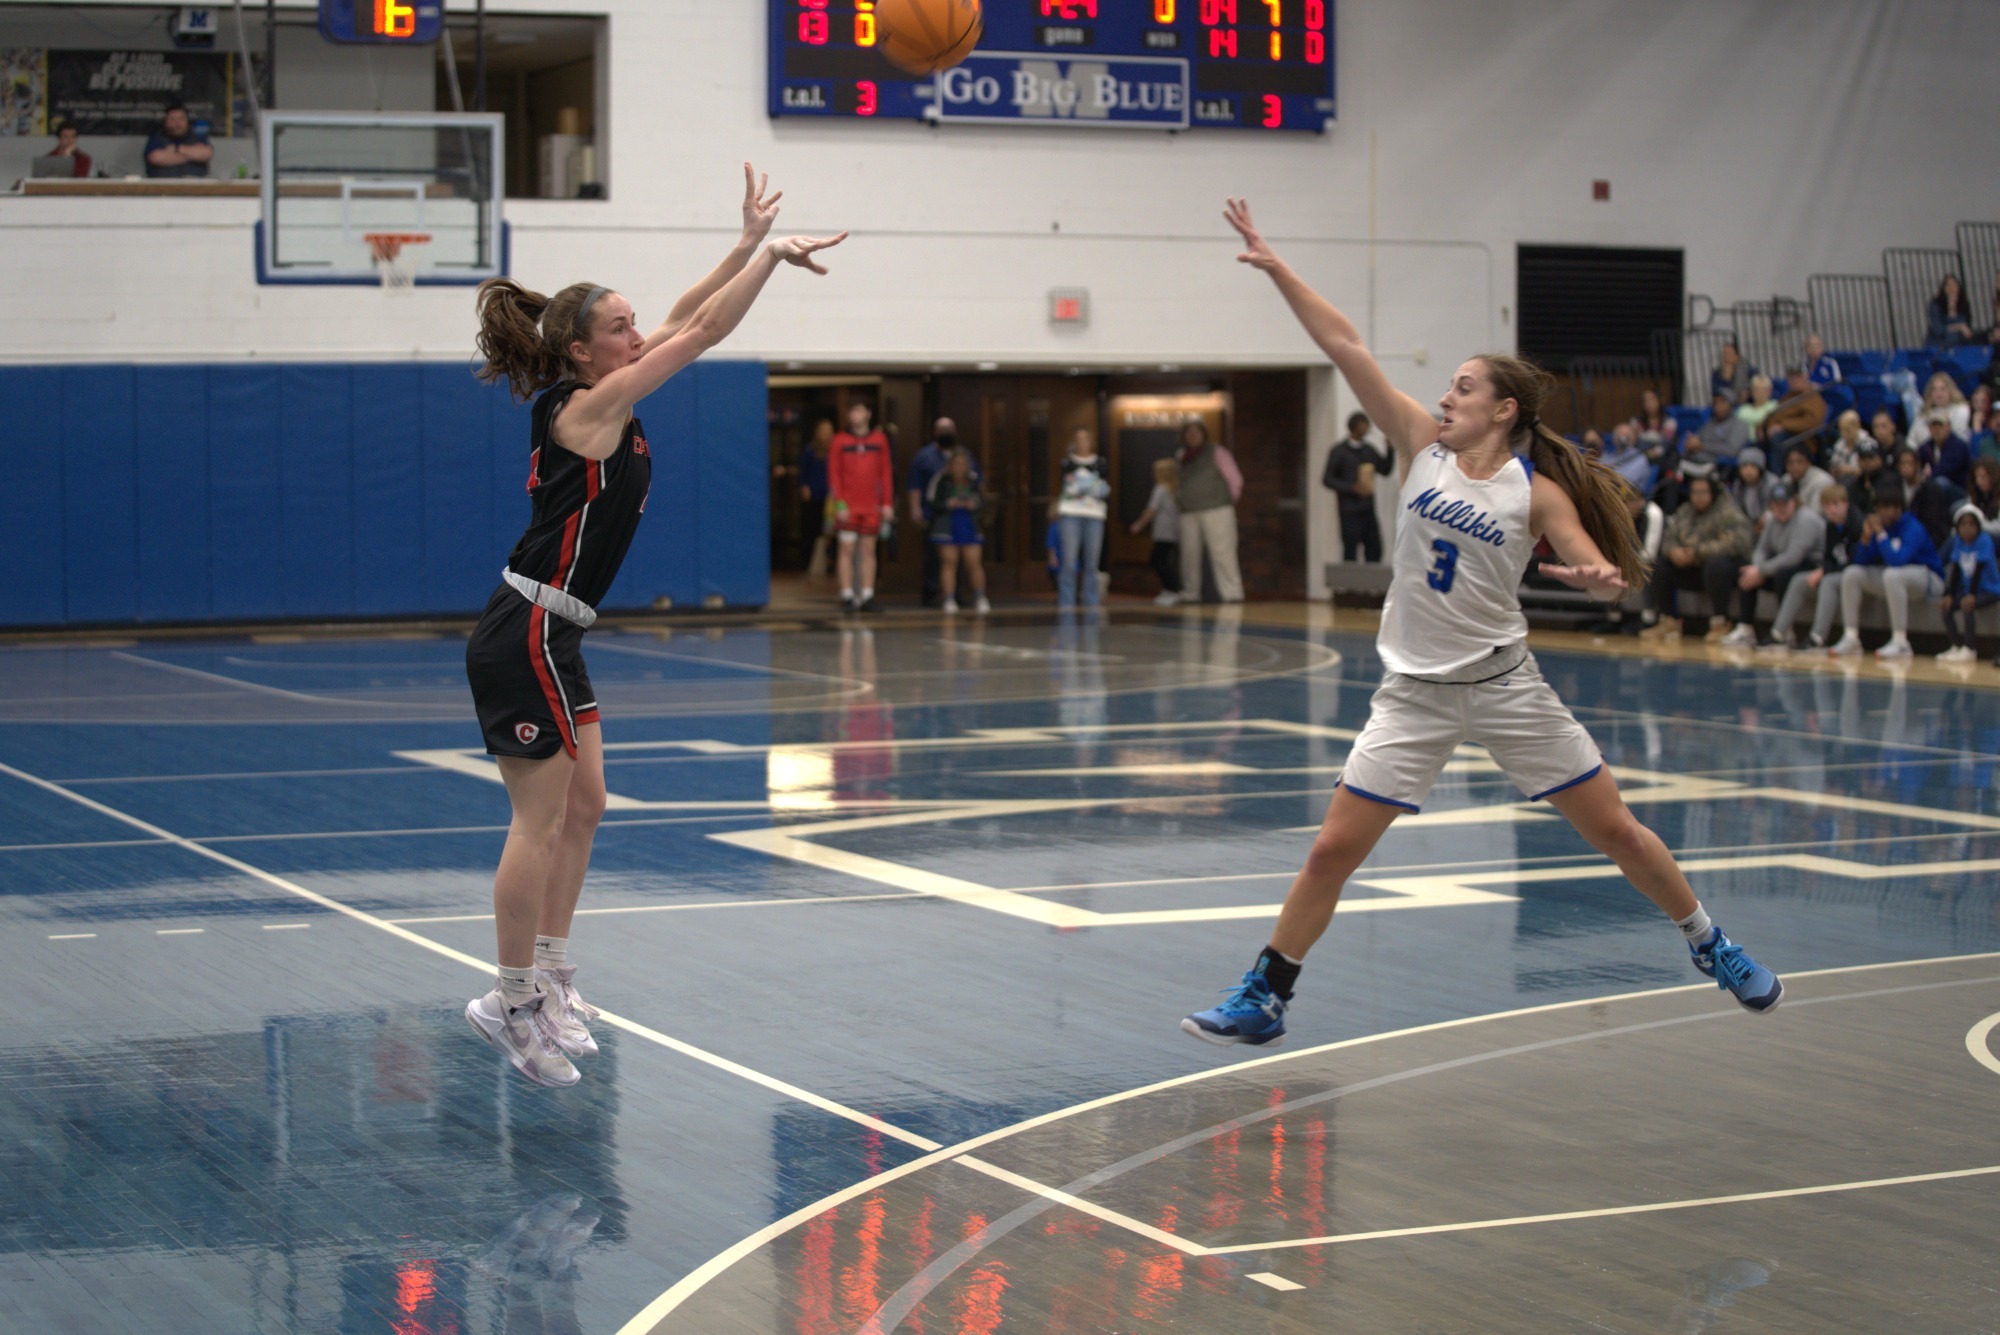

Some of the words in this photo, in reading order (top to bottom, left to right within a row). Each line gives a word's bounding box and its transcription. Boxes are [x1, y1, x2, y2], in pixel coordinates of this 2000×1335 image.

[1209, 29, 1237, 58] 14
[1304, 31, 1324, 64] 0
[88, 73, 113, 90] BE
[113, 74, 184, 91] POSITIVE
[855, 81, 877, 116] 3
[1262, 94, 1282, 128] 3
[1407, 487, 1506, 547] Millikin
[1427, 538, 1460, 594] 3
[520, 724, 535, 742] C
